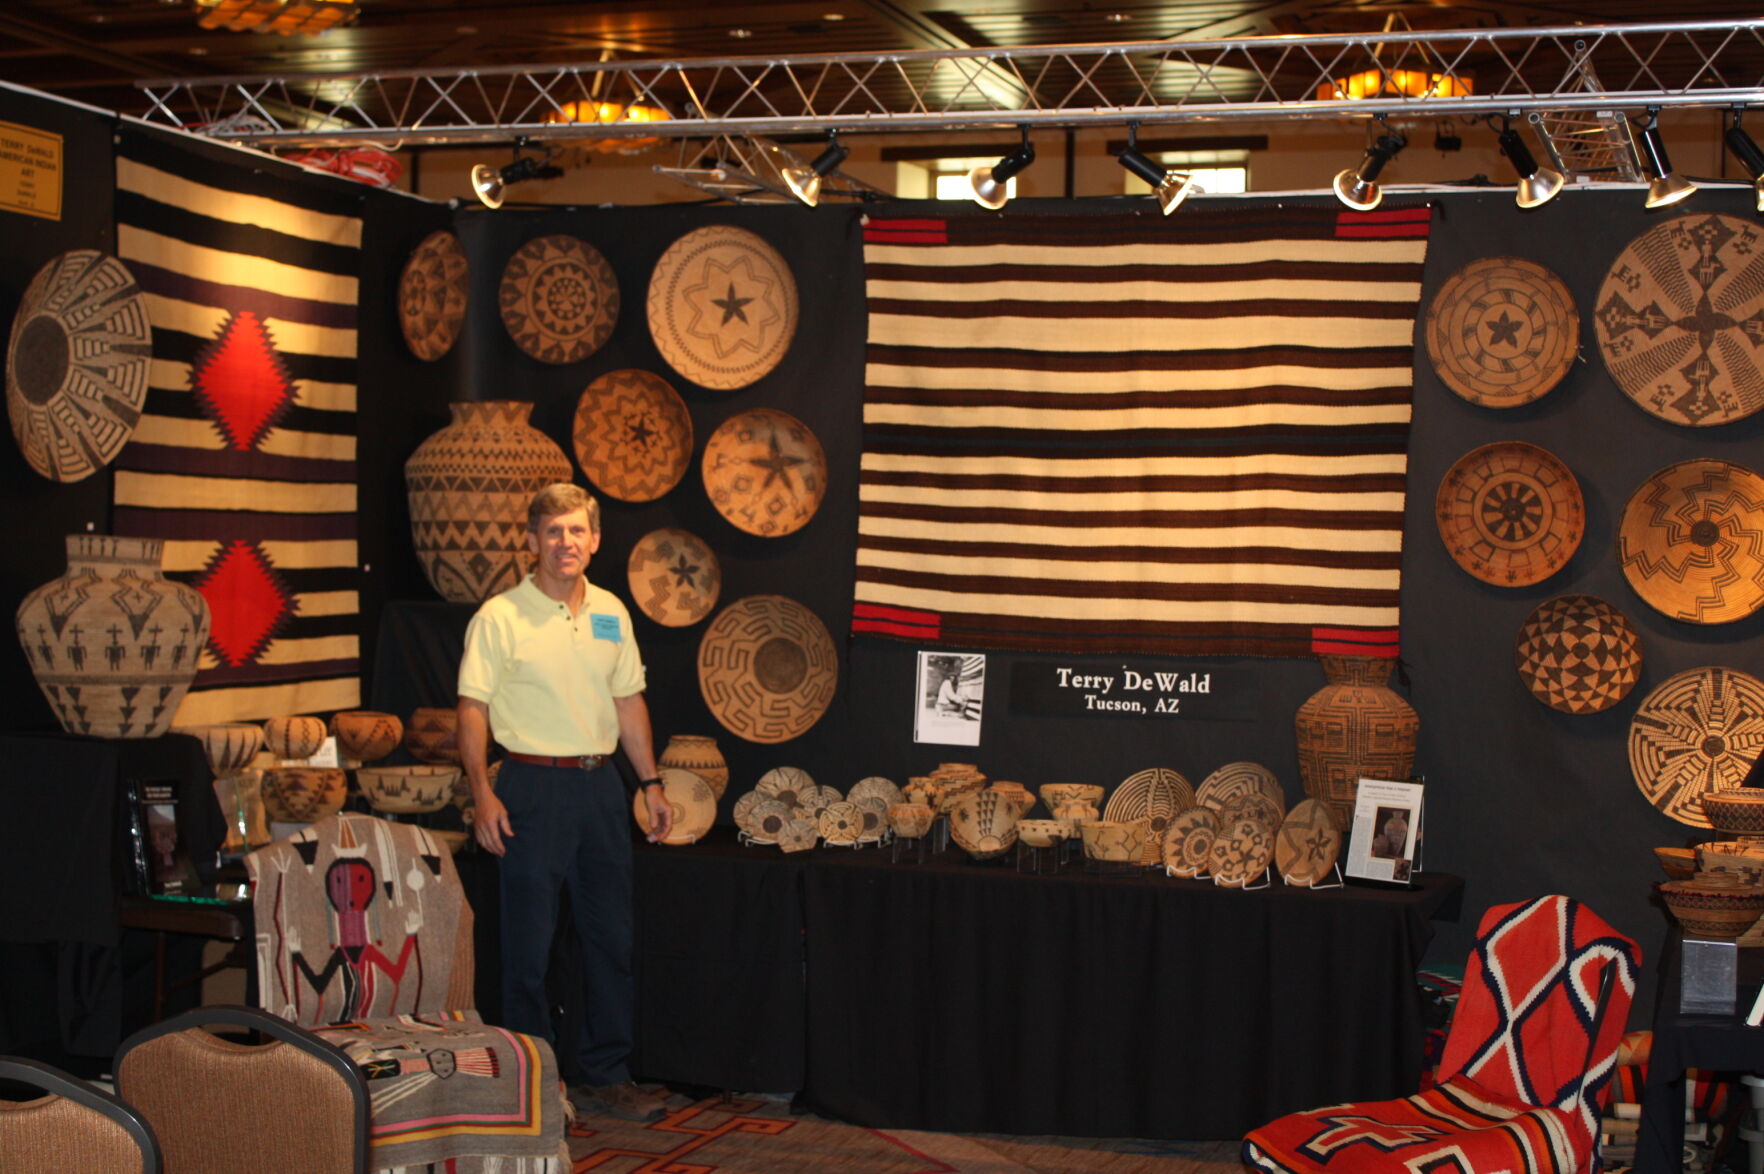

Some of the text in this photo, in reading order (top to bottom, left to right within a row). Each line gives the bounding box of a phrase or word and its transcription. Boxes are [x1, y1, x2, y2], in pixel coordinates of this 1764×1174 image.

[1, 138, 24, 150] TERRY
[35, 159, 57, 171] INDIAN
[20, 168, 35, 177] ART
[1056, 668, 1211, 694] Terry DeWald
[1084, 694, 1180, 715] Tucson, AZ
